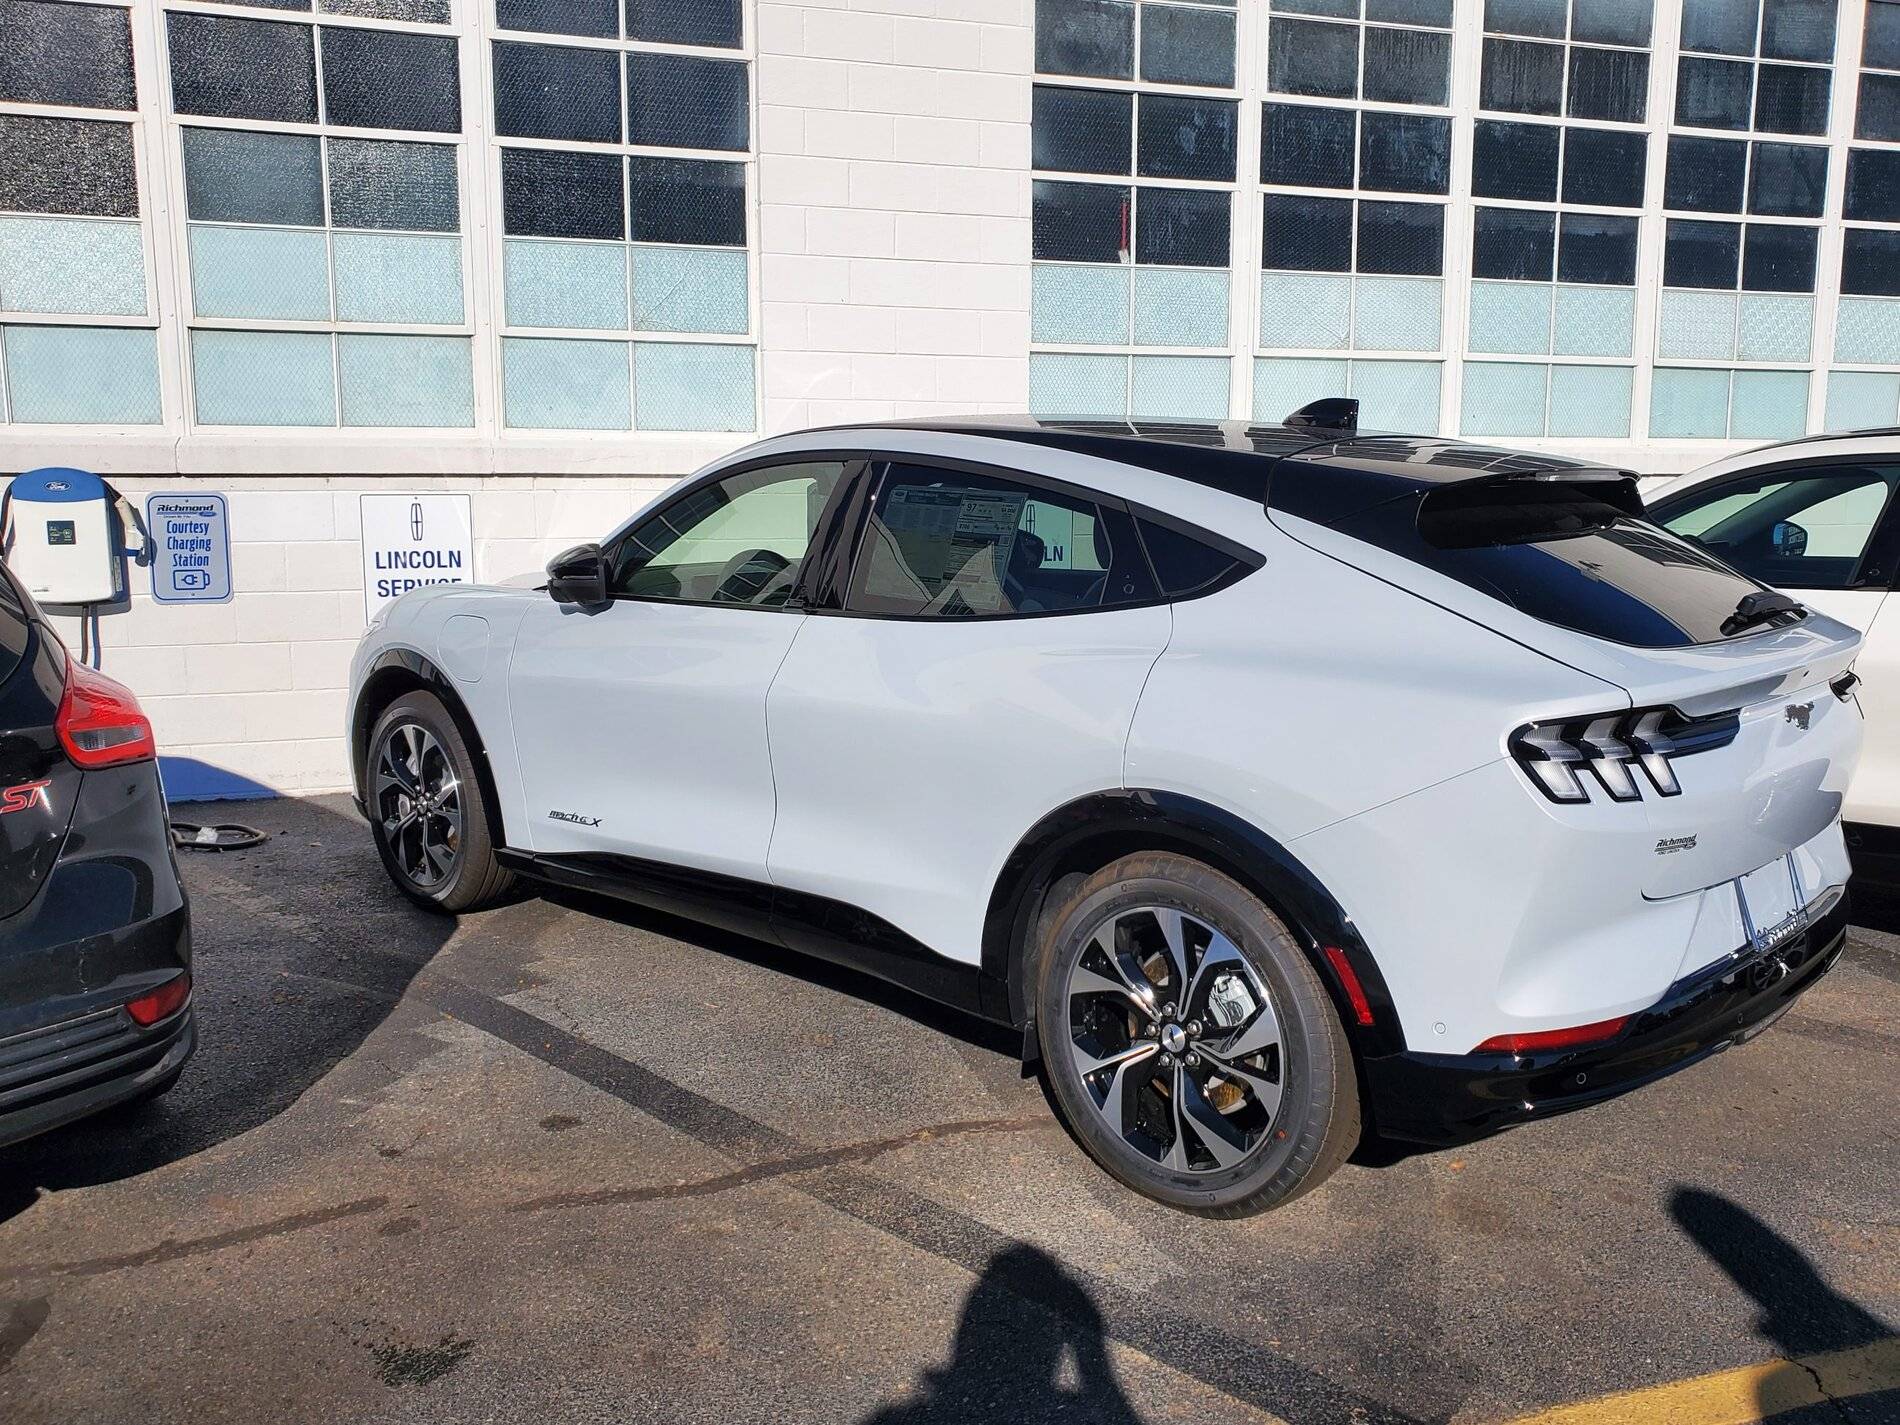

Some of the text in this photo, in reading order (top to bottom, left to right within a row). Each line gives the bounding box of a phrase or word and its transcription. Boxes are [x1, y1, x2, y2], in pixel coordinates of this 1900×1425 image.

[157, 504, 214, 512] Richmond
[166, 520, 210, 535] Courtesy
[167, 536, 212, 552] Charging
[172, 553, 209, 567] Station
[375, 550, 462, 569] LINCOLN
[0, 779, 52, 814] ST
[1655, 833, 1698, 848] Richmond
